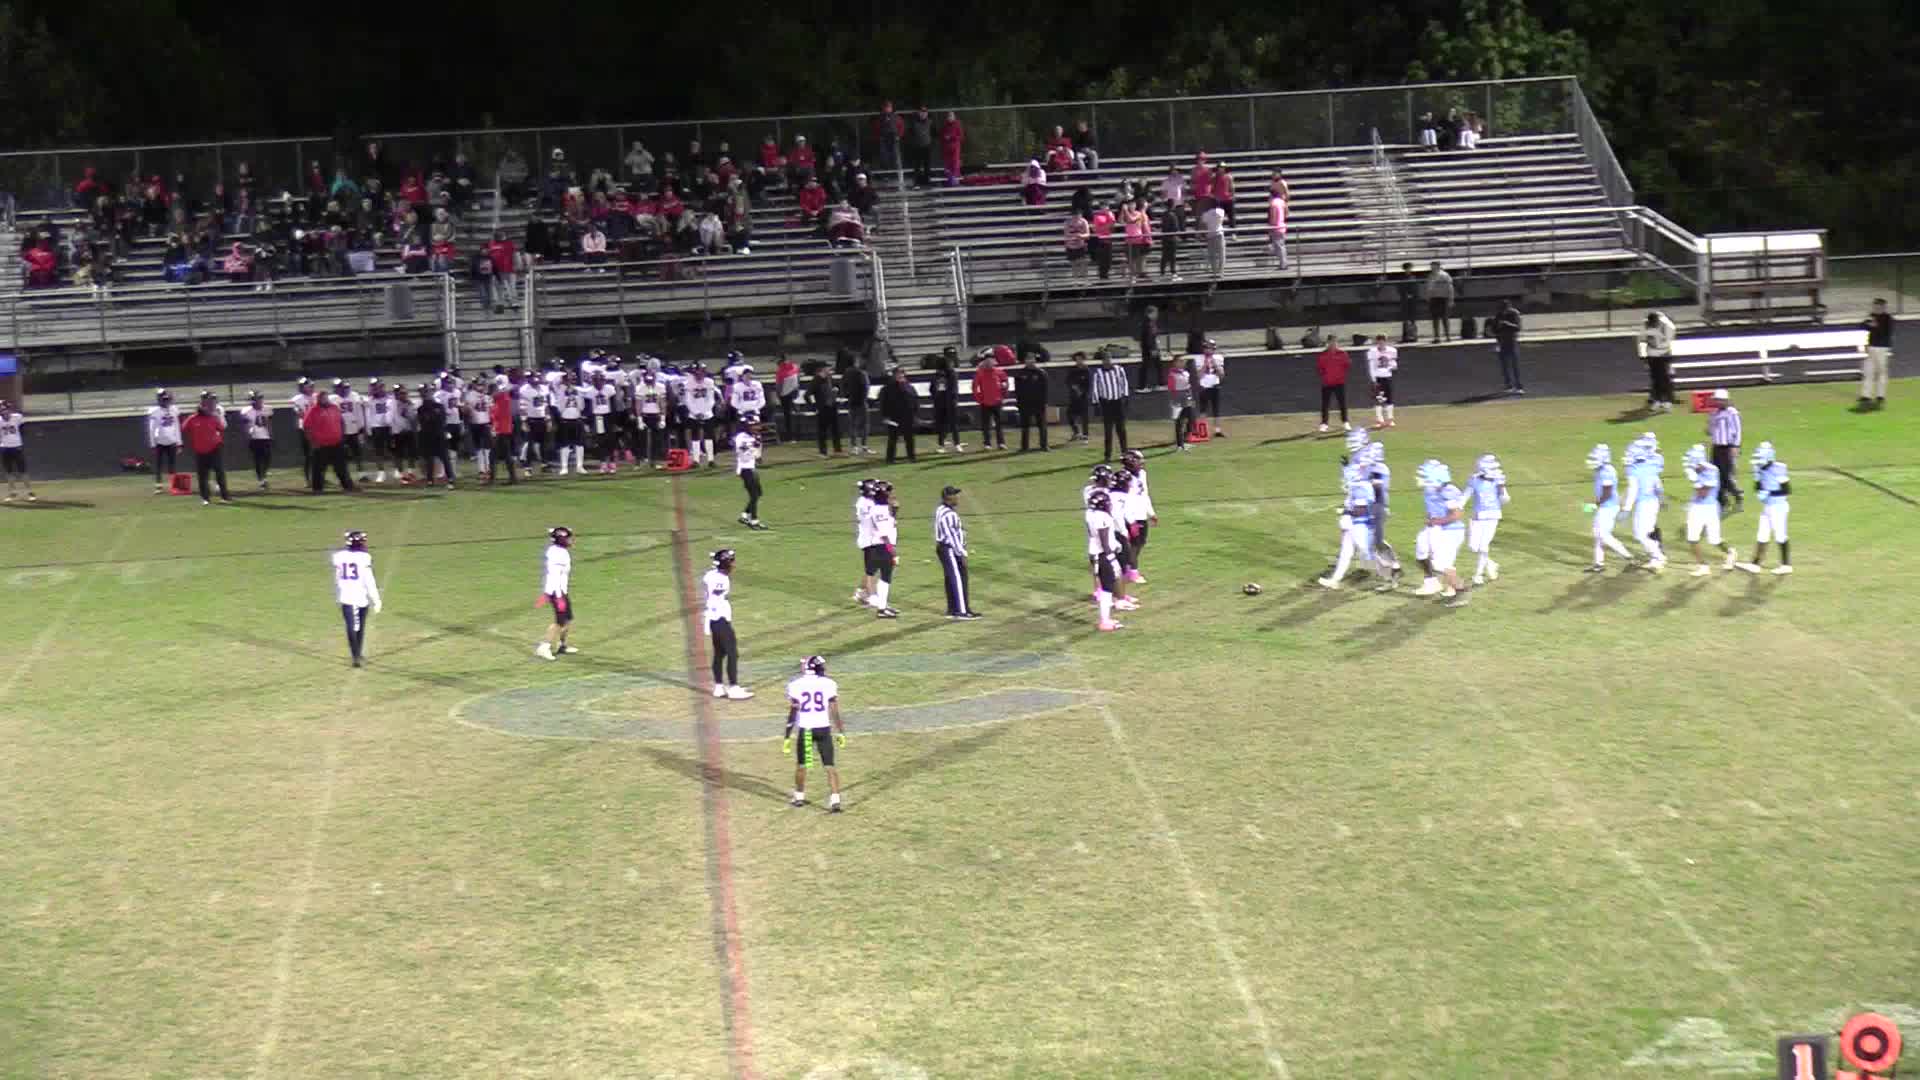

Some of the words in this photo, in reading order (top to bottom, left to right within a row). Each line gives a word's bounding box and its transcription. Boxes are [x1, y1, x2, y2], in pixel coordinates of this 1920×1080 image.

[668, 451, 685, 467] 50
[341, 562, 359, 580] 13
[800, 691, 826, 713] 29
[1792, 1043, 1816, 1080] 1
